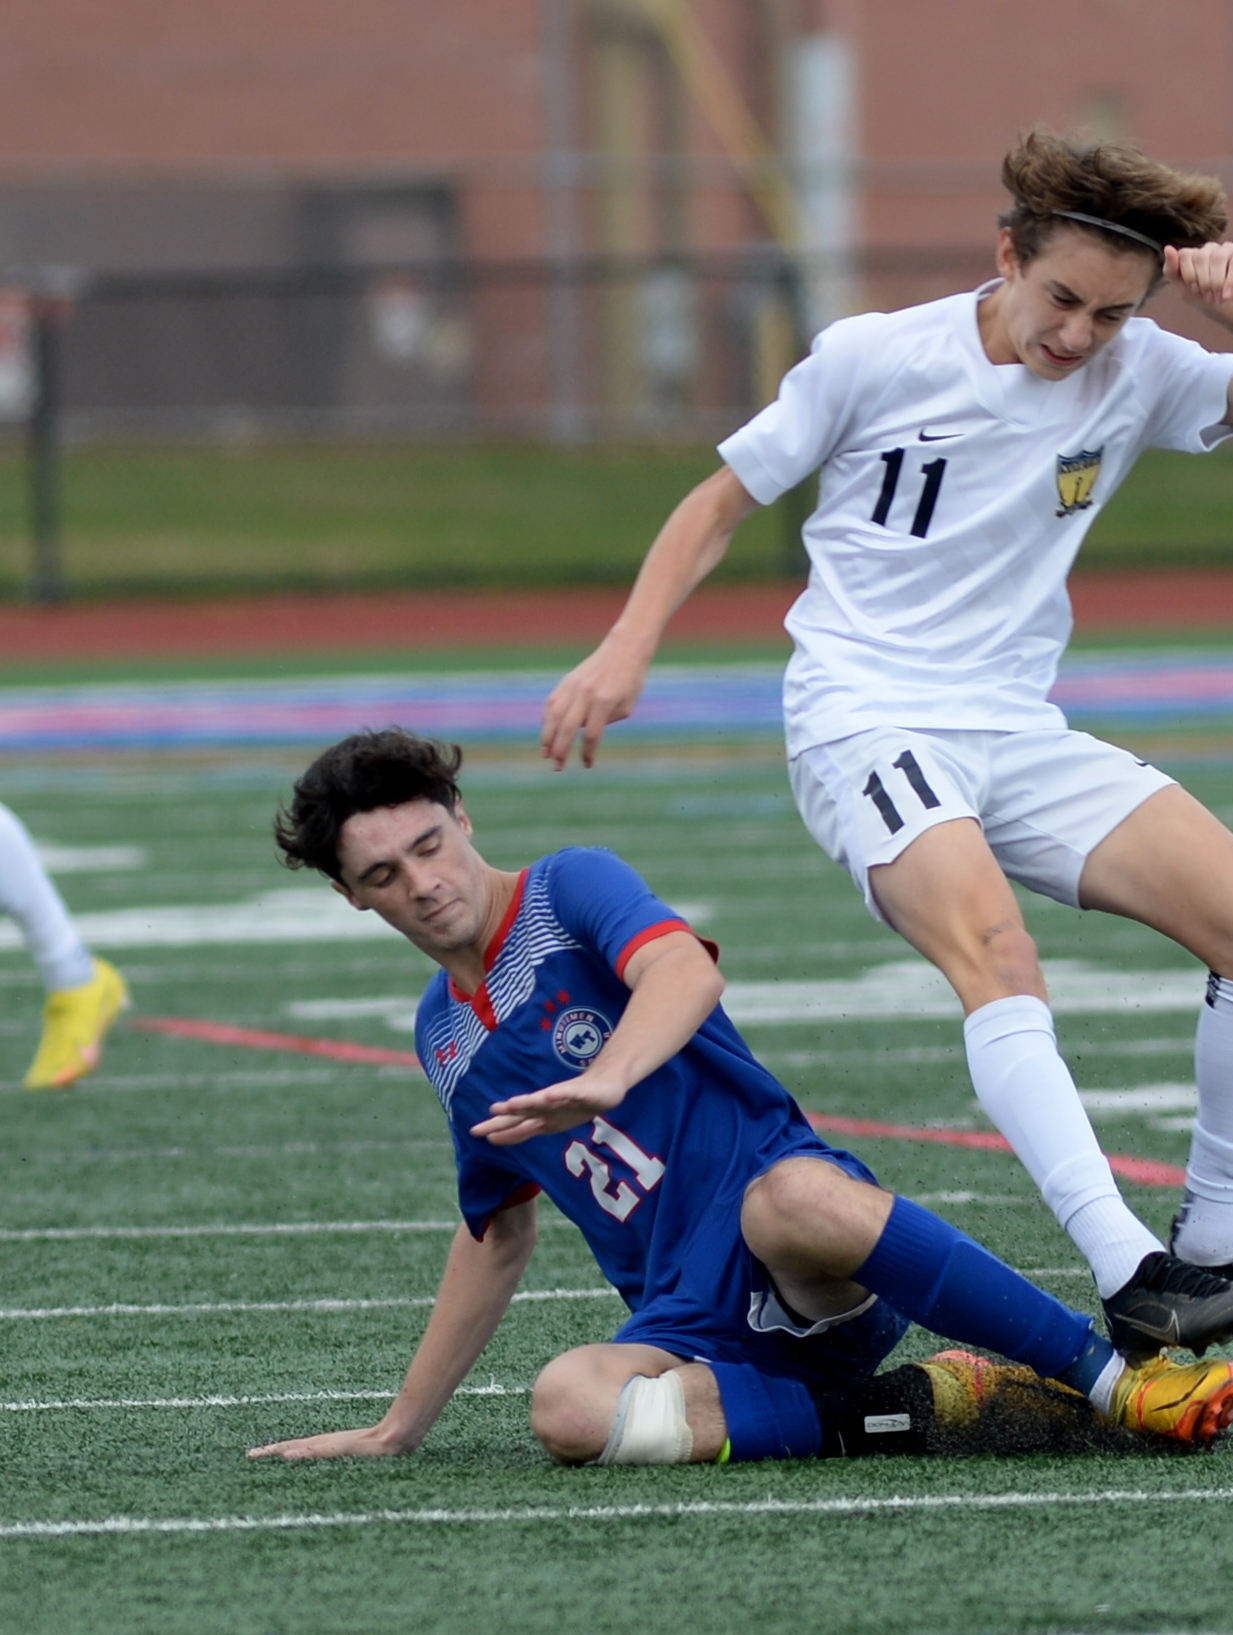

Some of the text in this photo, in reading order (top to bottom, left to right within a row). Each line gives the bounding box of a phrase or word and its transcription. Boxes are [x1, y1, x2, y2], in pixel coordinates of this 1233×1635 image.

[869, 447, 947, 539] 11
[862, 749, 942, 836] 11
[556, 1012, 595, 1054] MINUTEMEN
[569, 1029, 596, 1050] WT
[564, 1116, 667, 1223] 21
